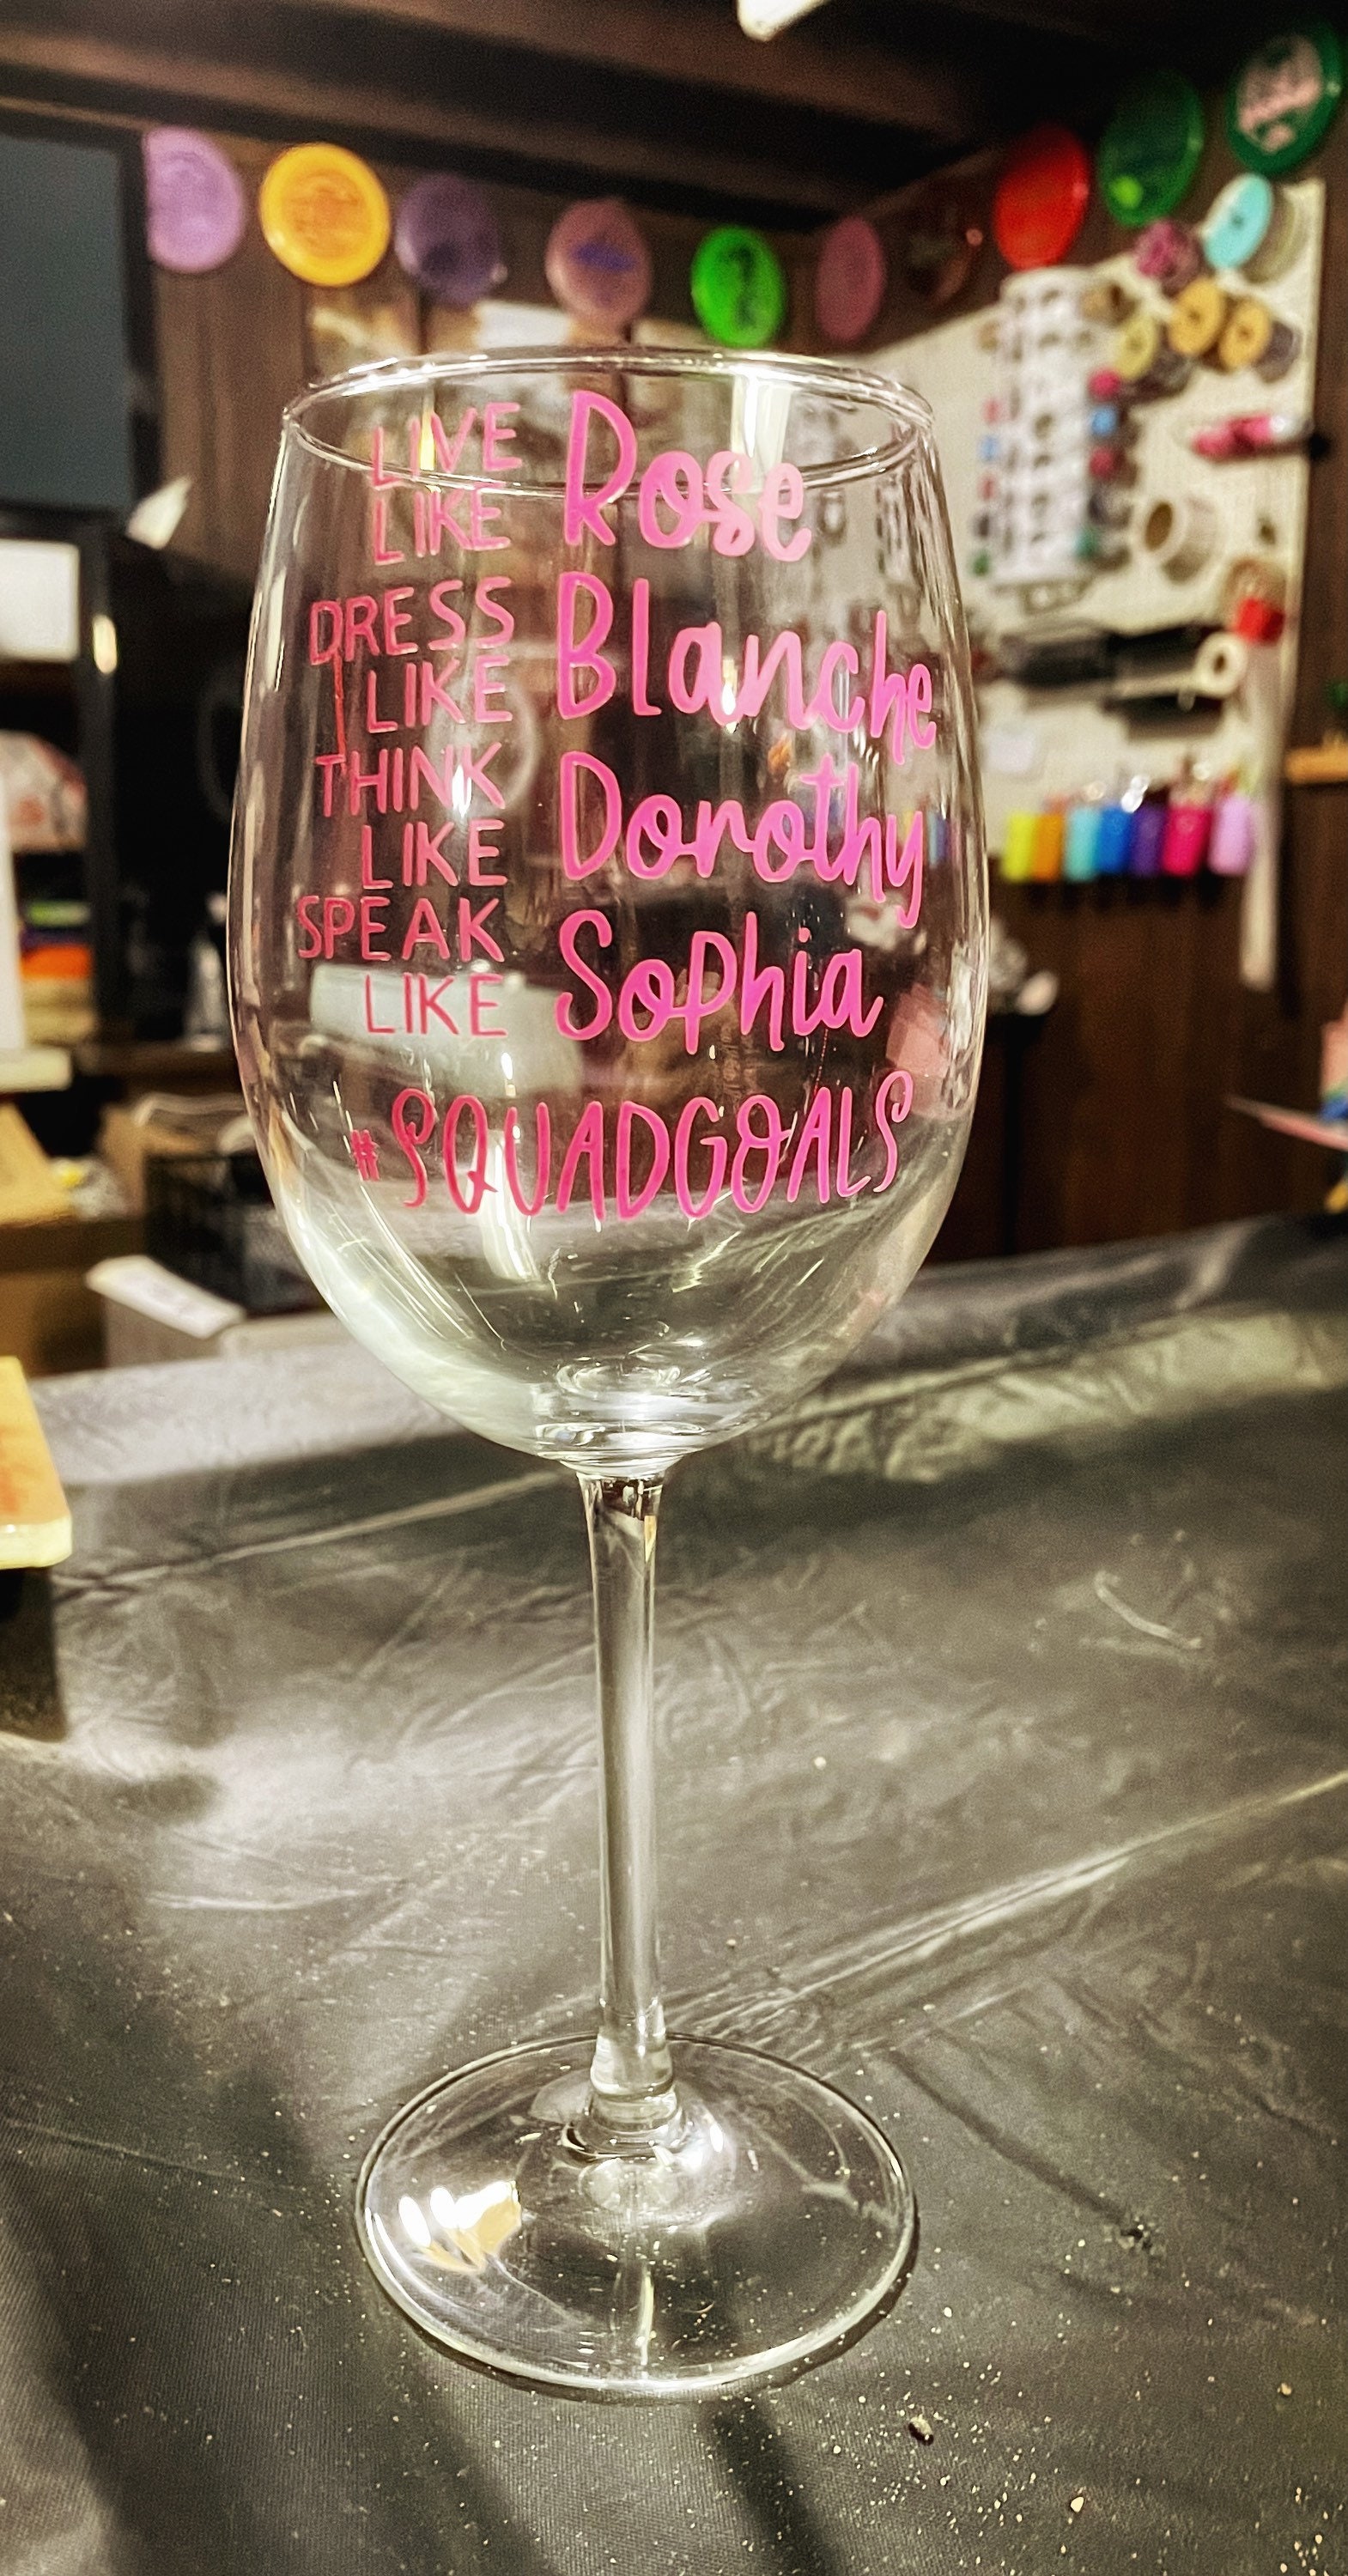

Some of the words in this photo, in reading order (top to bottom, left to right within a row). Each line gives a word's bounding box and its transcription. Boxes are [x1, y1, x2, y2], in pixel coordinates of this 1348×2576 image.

[370, 401, 523, 487] LIVE
[564, 391, 812, 562] Rose
[373, 481, 512, 566] LIKE
[309, 576, 516, 666] DRESS
[367, 654, 513, 734] LIKE
[556, 571, 937, 766] Blanche
[316, 741, 506, 817] THINK
[361, 818, 508, 890] LIKE
[560, 750, 924, 929] Dorothy
[296, 894, 505, 963] SPEAK
[365, 972, 507, 1039] LIKE
